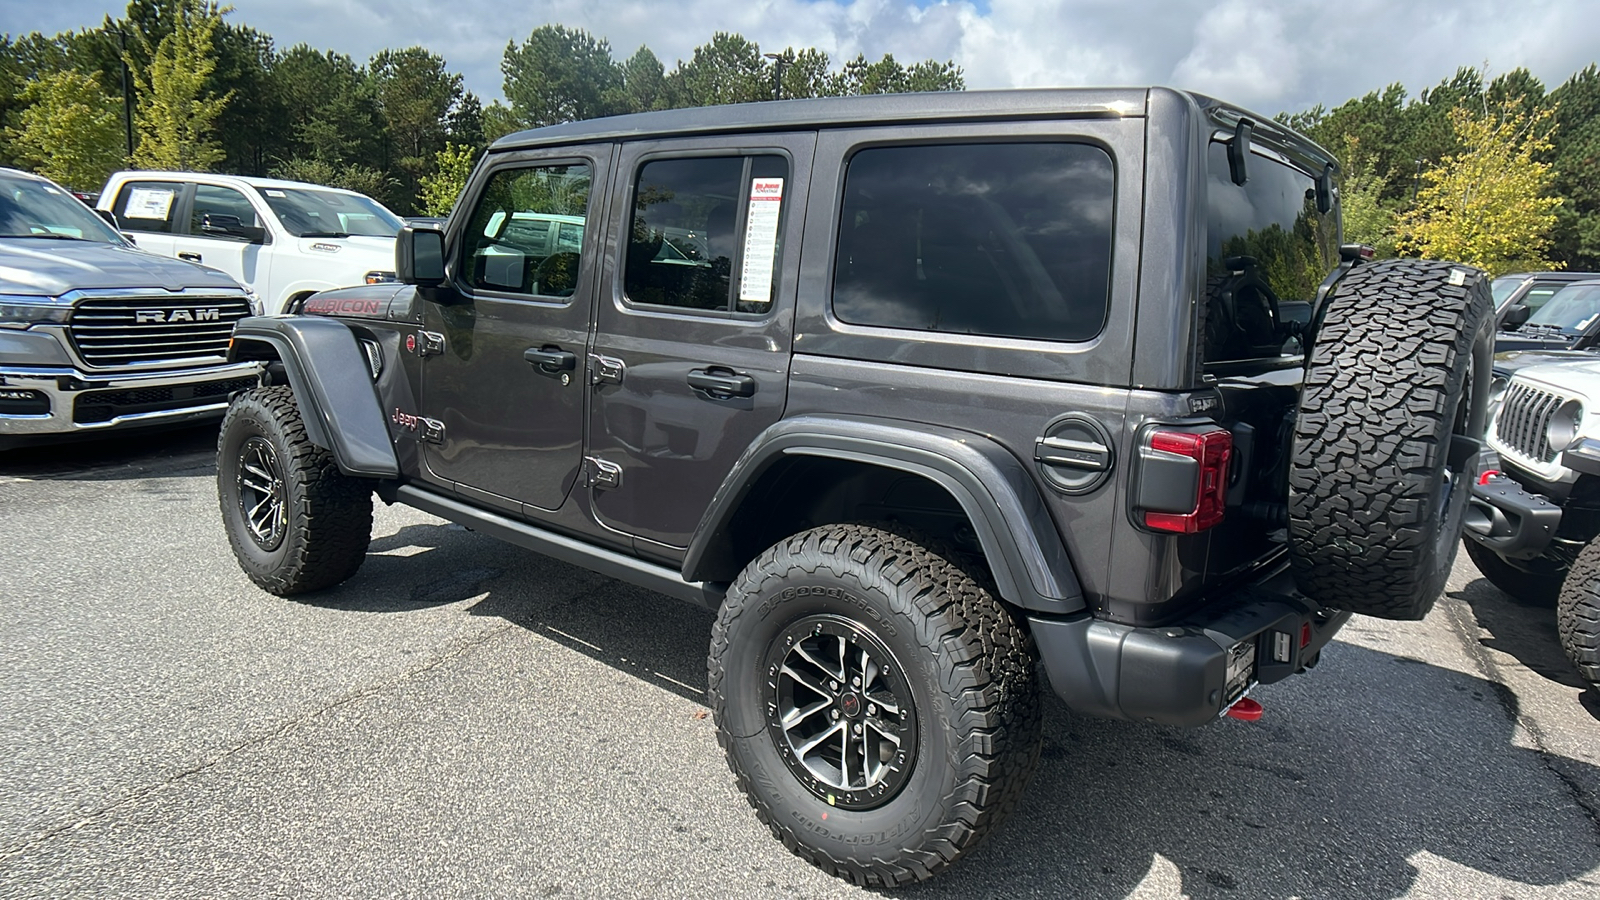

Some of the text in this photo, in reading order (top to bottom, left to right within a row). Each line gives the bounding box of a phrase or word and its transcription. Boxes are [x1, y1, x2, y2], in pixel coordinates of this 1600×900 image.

[304, 298, 381, 315] RUBICON
[136, 308, 219, 323] RAM
[392, 407, 418, 432] Jeep
